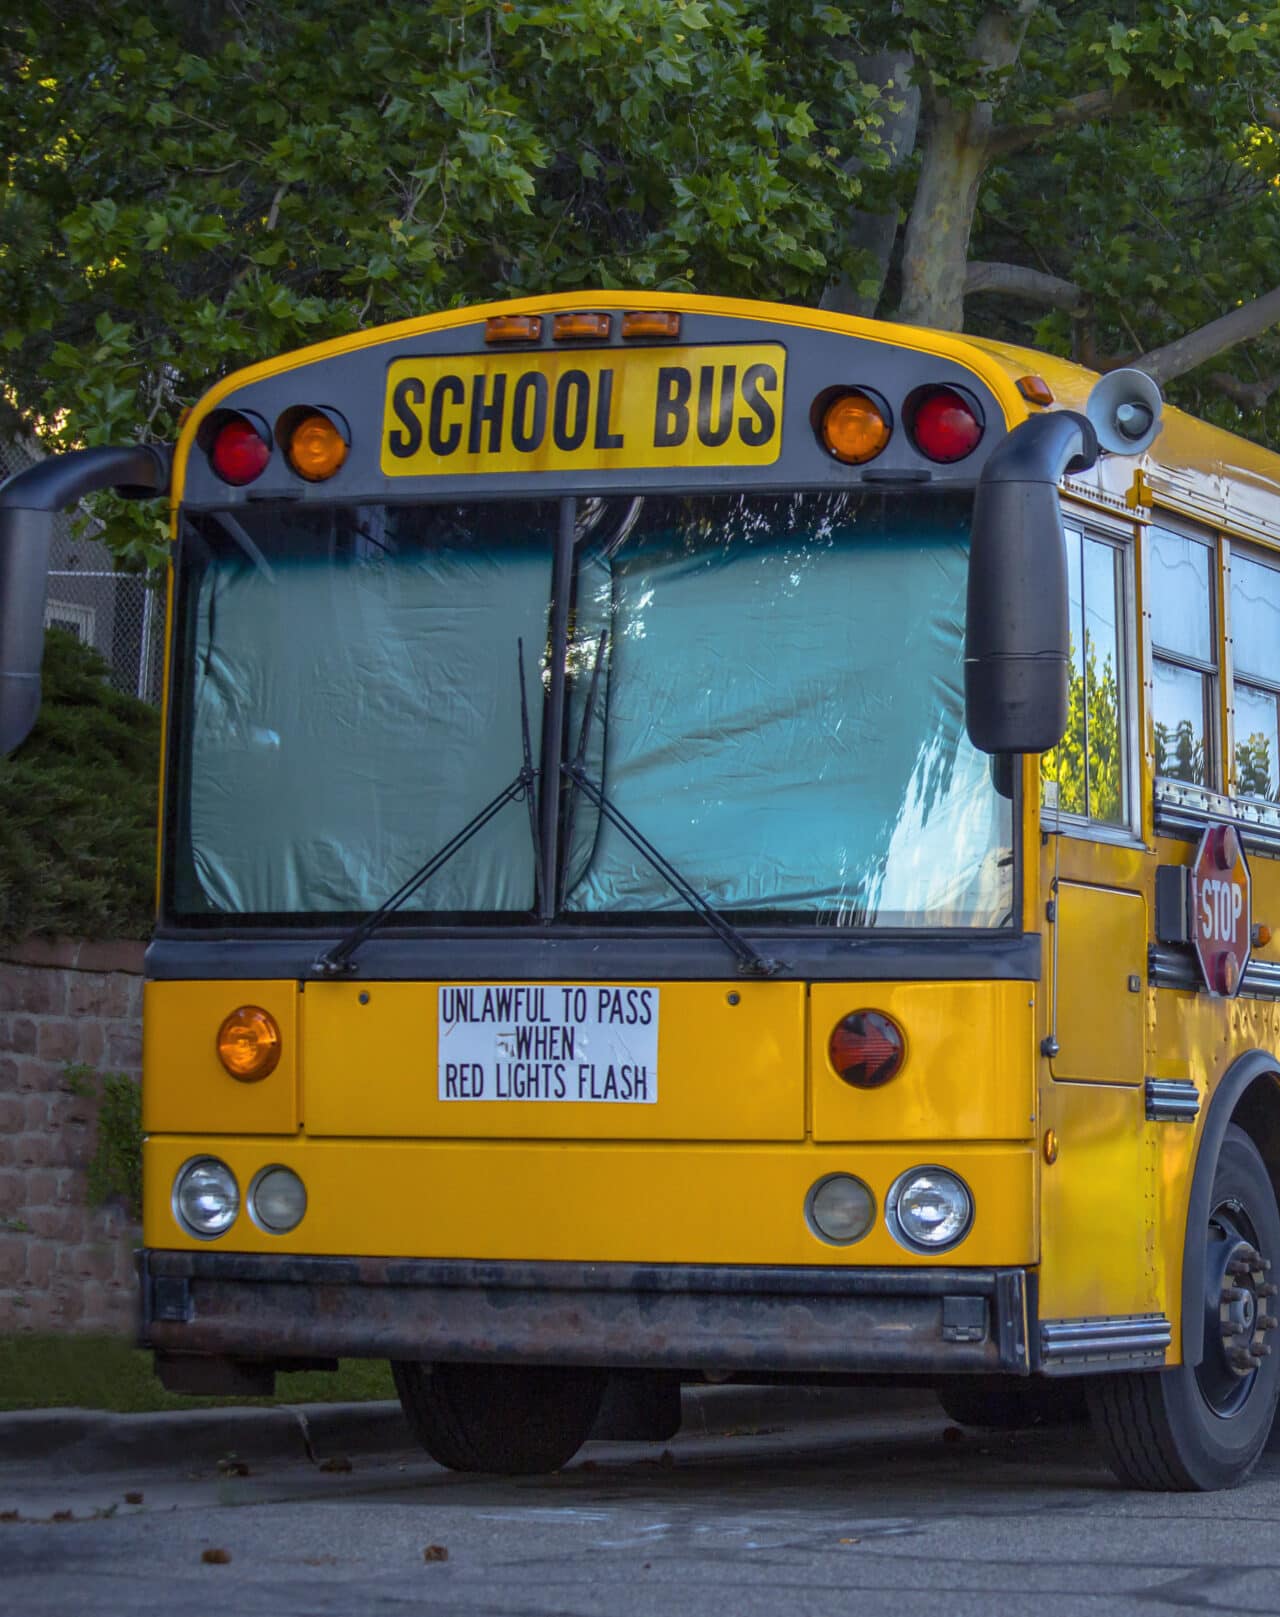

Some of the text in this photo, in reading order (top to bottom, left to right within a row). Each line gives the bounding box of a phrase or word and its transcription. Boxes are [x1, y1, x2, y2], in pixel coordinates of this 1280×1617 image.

[389, 363, 778, 458] SCHOOL BUS
[1202, 879, 1242, 943] STOP
[442, 988, 652, 1025] UNLAWFUL TO PASS
[516, 1026, 575, 1060] WHEN
[446, 1064, 647, 1100] RED LIGHTS FLASH
